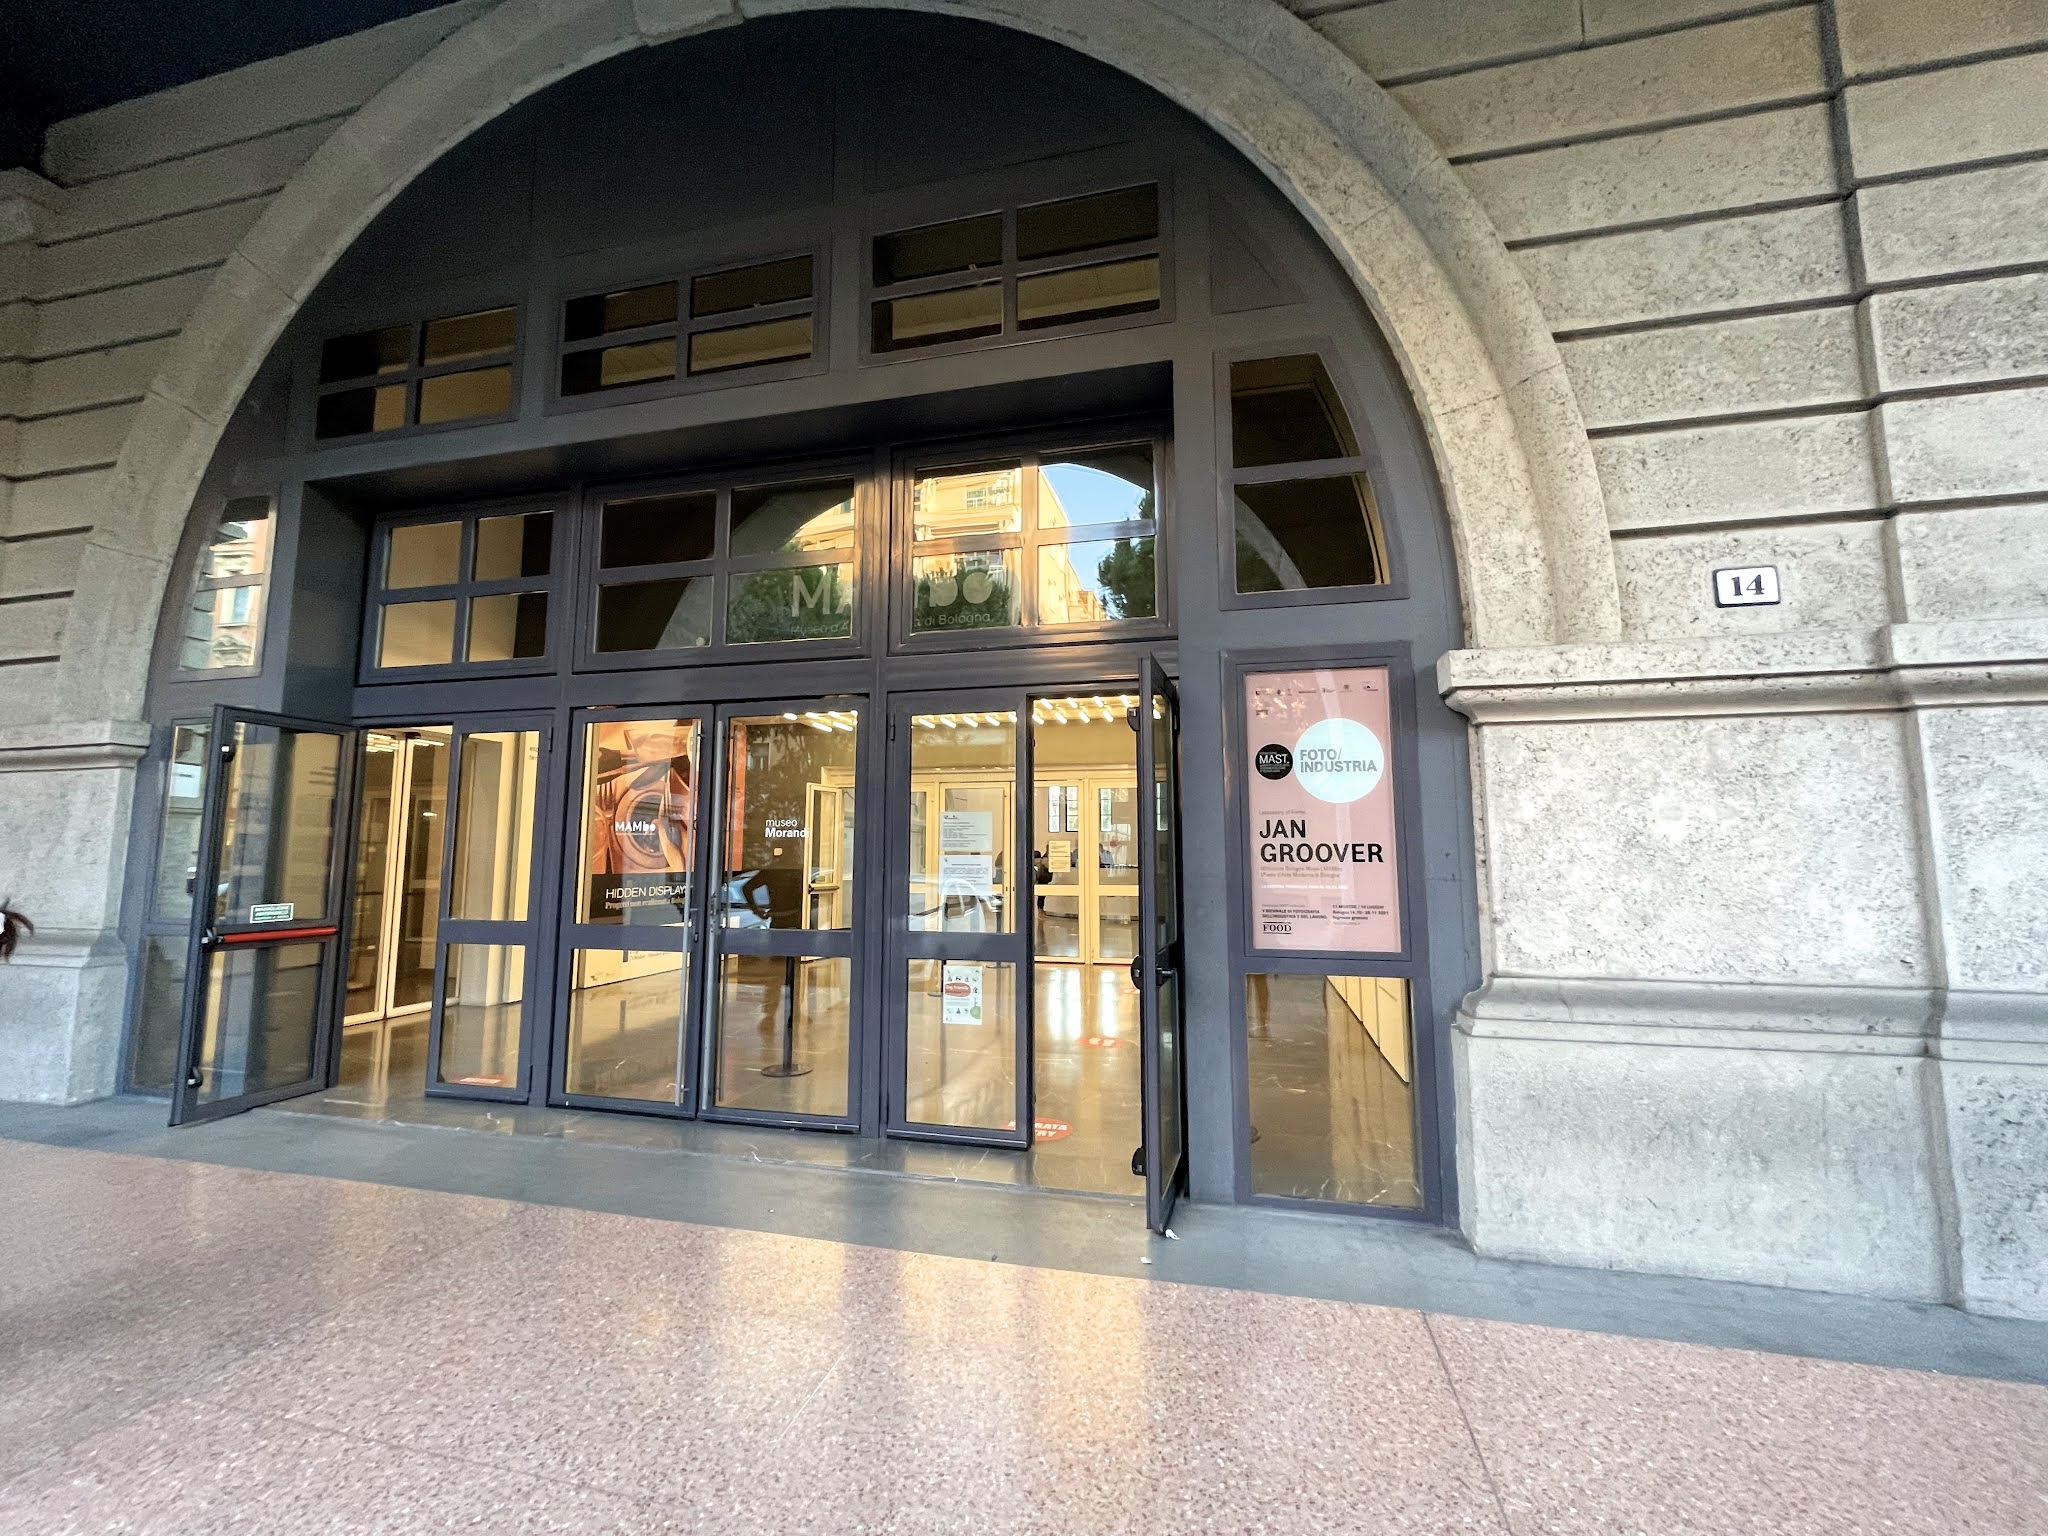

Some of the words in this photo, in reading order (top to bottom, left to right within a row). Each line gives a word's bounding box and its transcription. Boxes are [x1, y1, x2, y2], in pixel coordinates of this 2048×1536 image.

[1731, 574, 1765, 596] 14
[1300, 759, 1378, 773] INDUSTRIA
[615, 820, 656, 832] MAMbo
[766, 819, 798, 827] museo
[1259, 819, 1306, 838] JAN
[1260, 843, 1384, 863] GROOVER
[605, 887, 646, 899] HIDDEN
[1262, 924, 1292, 932] FOOD
